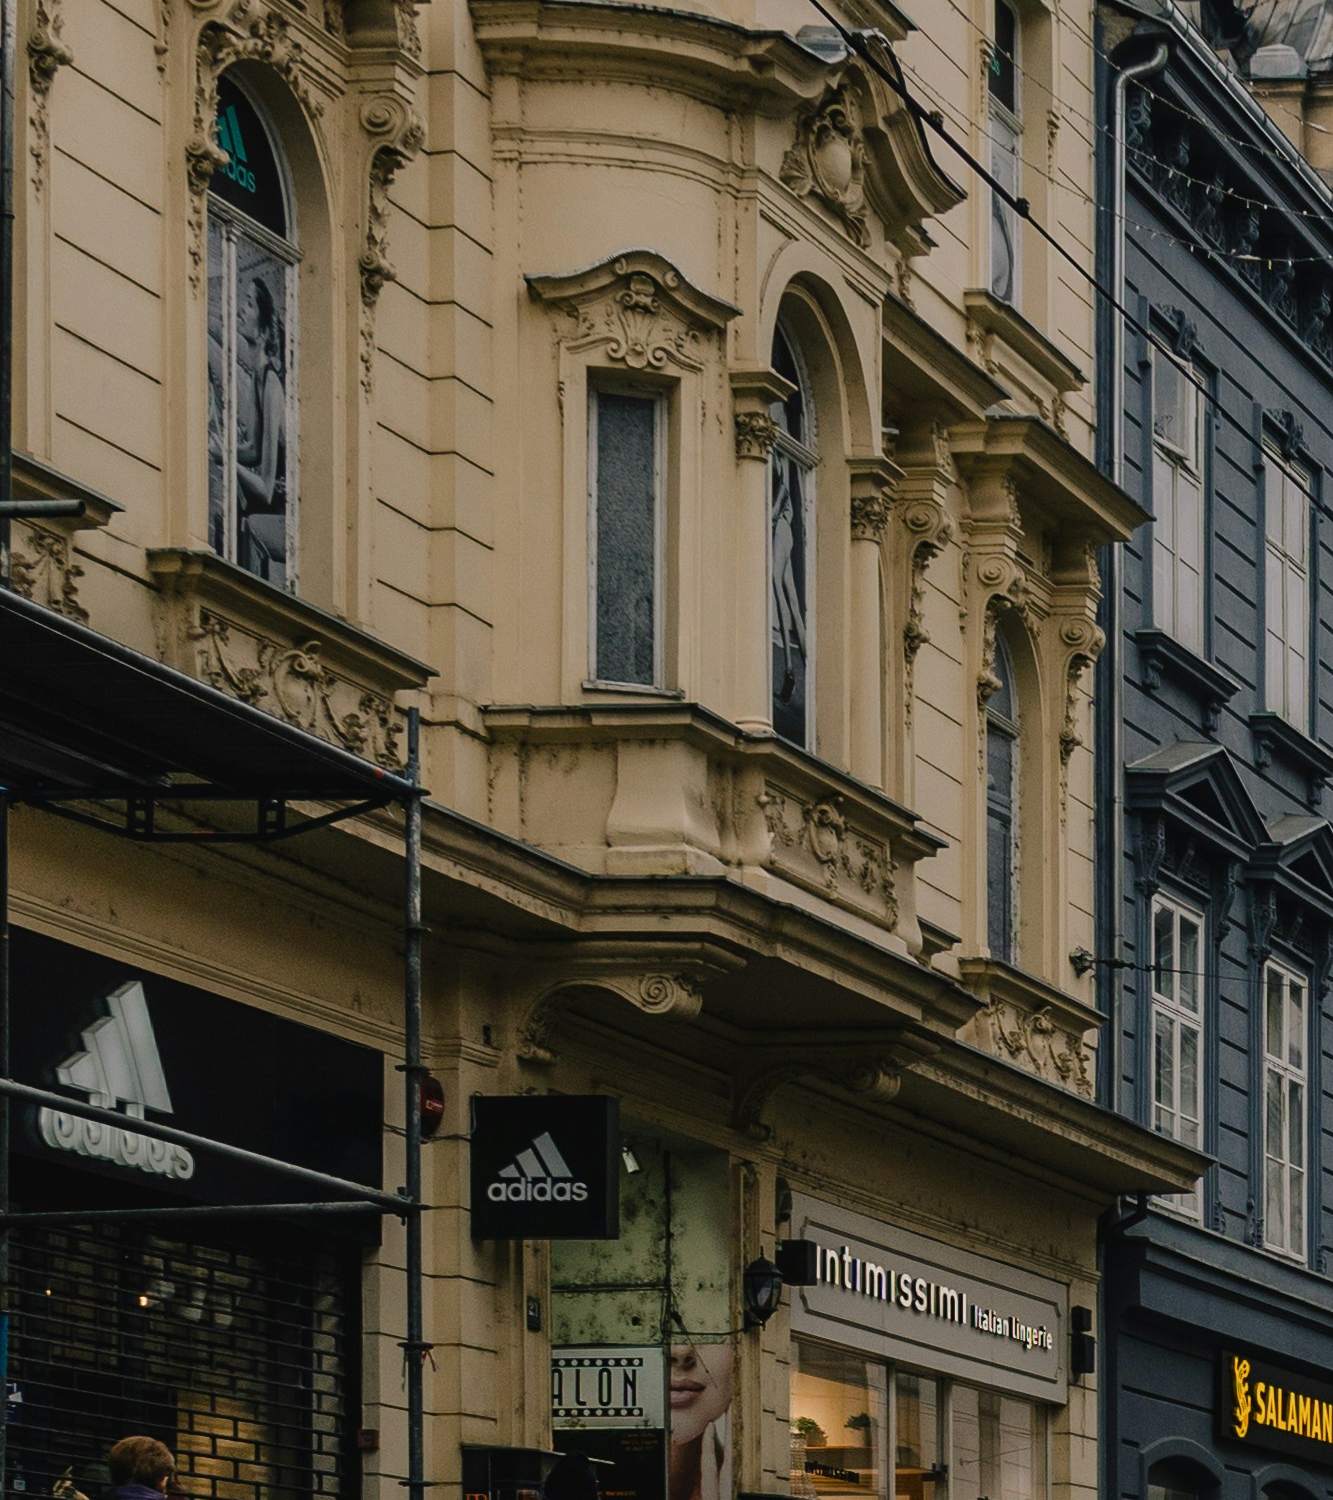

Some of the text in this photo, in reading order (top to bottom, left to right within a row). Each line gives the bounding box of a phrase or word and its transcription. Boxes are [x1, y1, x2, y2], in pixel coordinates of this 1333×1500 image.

[487, 1176, 589, 1202] adidas
[973, 1304, 1010, 1338] Italian
[1010, 1316, 1053, 1351] lingerie
[552, 1368, 637, 1407] ALON
